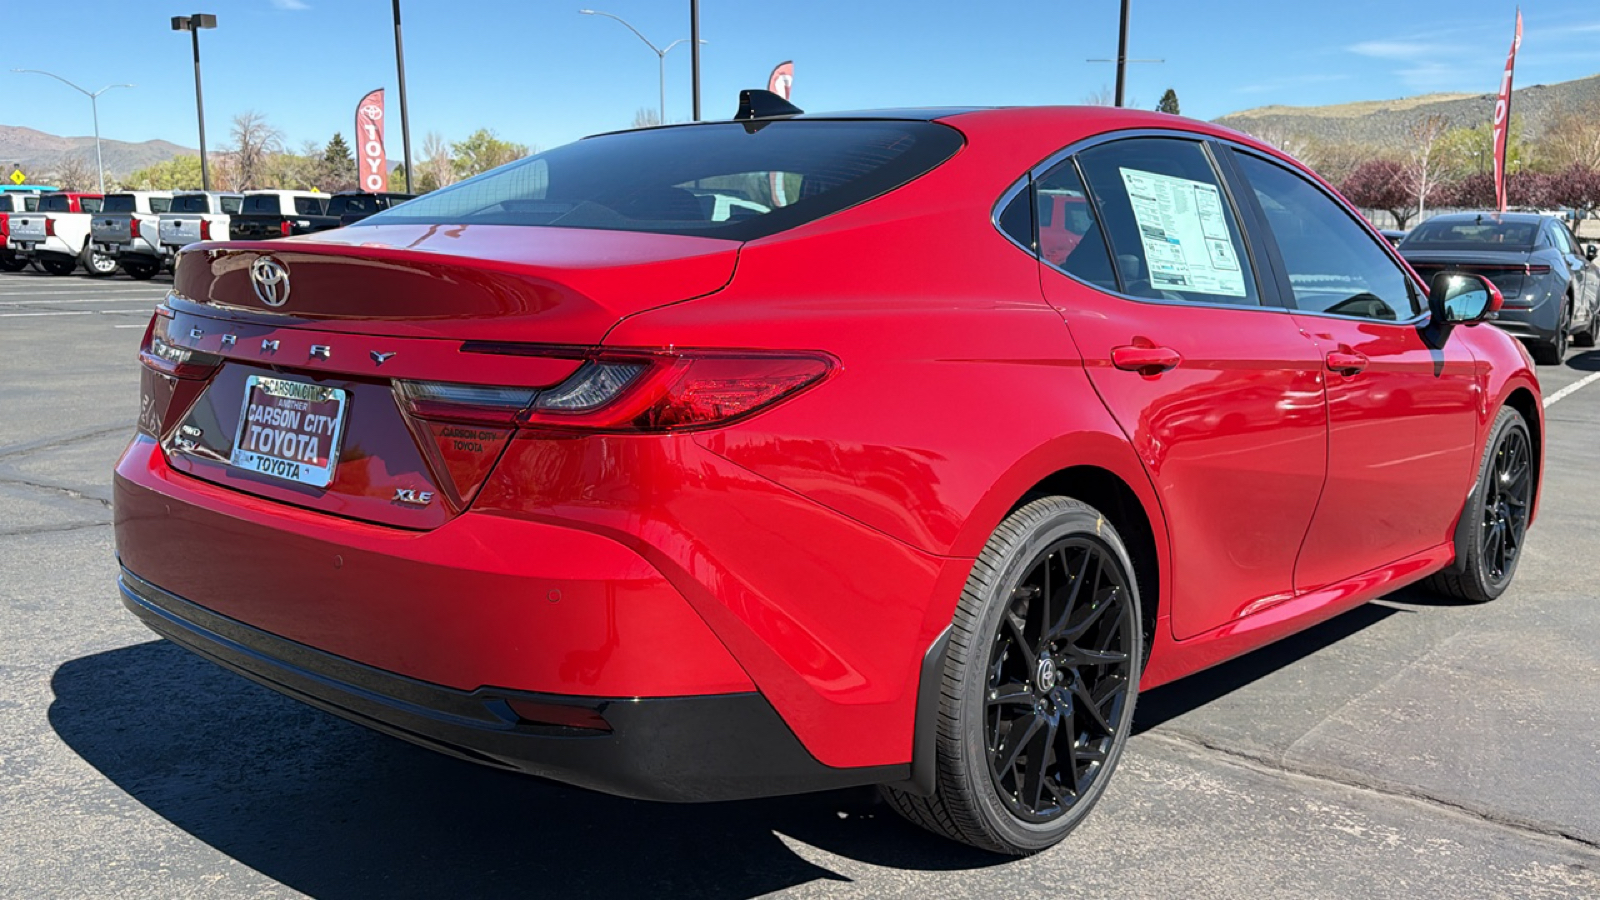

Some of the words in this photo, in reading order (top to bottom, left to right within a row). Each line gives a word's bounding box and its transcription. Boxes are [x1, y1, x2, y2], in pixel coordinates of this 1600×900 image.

[364, 124, 382, 190] TOYO
[190, 328, 397, 367] CAMRY
[269, 379, 301, 397] CARSON
[278, 399, 308, 411] ANOTHER
[248, 404, 301, 430] CARSON
[304, 413, 337, 436] CITY
[250, 425, 319, 464] TOYOTA
[443, 427, 477, 440] CARSON
[478, 430, 497, 442] CITY
[454, 440, 483, 452] TOYOTA
[256, 455, 300, 480] TOYOTA
[391, 488, 434, 505] XLE
